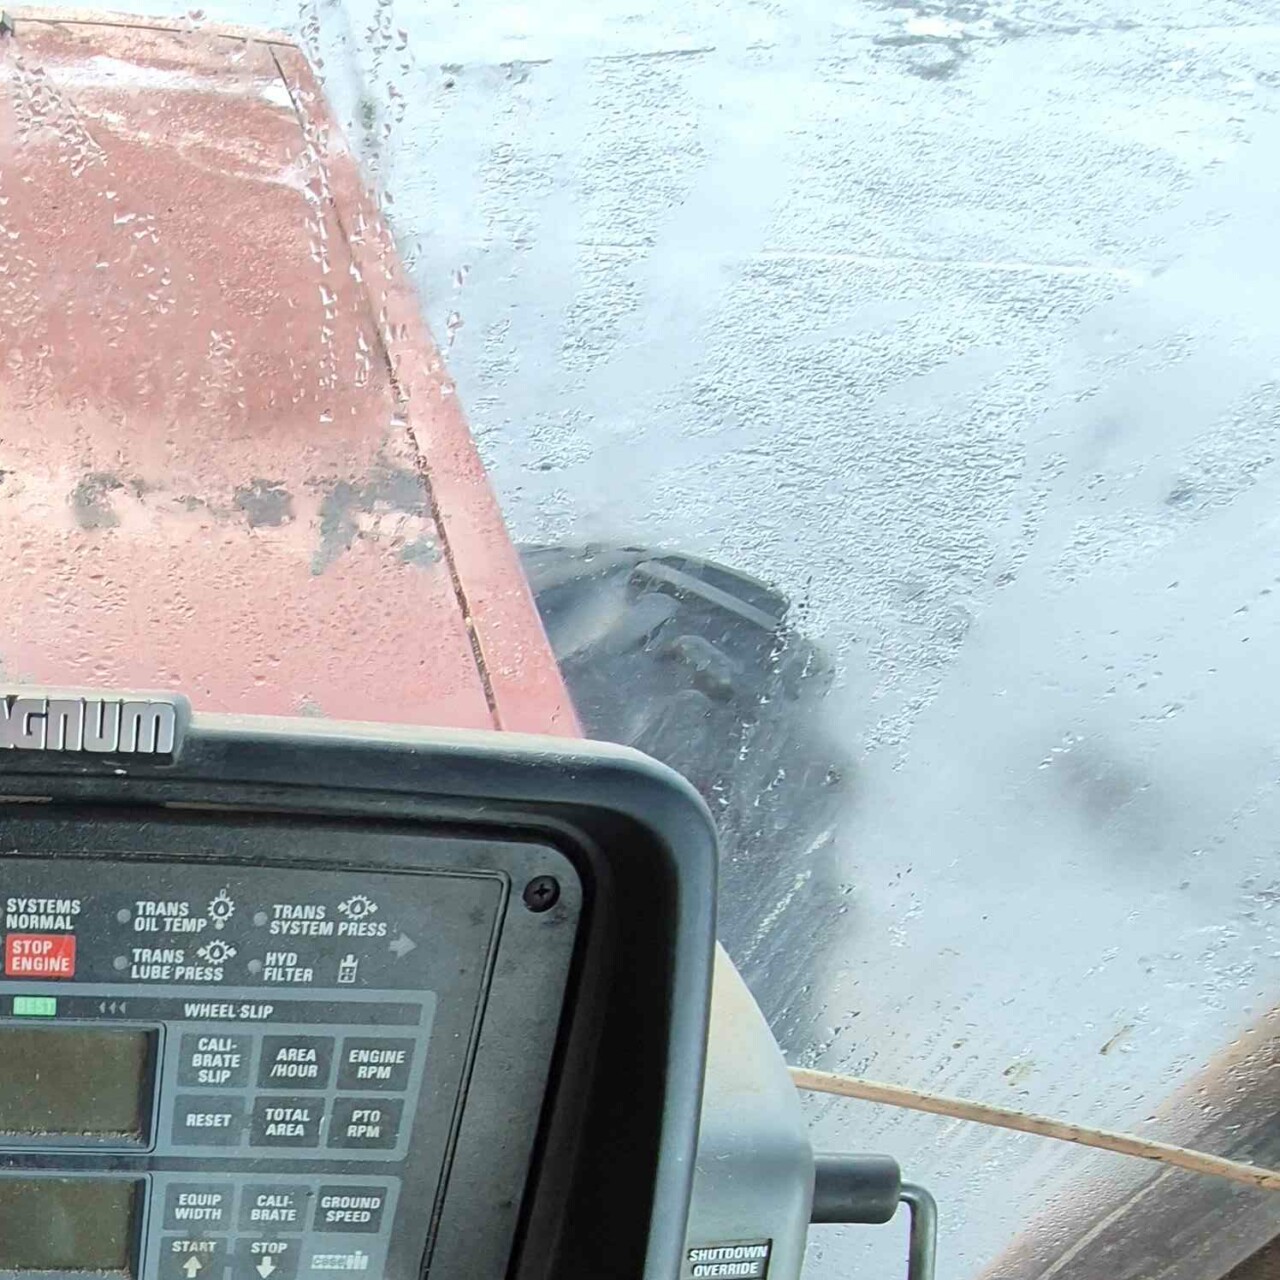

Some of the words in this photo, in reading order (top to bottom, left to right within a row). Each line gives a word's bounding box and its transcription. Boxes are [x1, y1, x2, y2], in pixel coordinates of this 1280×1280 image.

[6, 898, 81, 914] SYSTEMS
[136, 901, 189, 916] TRANS
[273, 904, 326, 920] TRANS
[6, 914, 74, 930] NORMAL
[134, 917, 159, 931] OIL
[163, 917, 208, 933] TEMP
[270, 921, 333, 936] SYSTEM
[337, 922, 387, 937] PRESS
[12, 940, 52, 955] STOP
[132, 948, 185, 964] TRANS
[266, 952, 297, 967] HYD
[12, 957, 70, 972] ENGINE
[131, 965, 171, 979] LUBE
[174, 967, 224, 981] PRESS
[264, 967, 313, 982] FILTER
[184, 1003, 237, 1018] WHEEL
[239, 1004, 273, 1019] SLIP
[198, 1038, 238, 1051] CALI-
[192, 1054, 241, 1068] BRATE
[277, 1048, 317, 1062] AREA
[349, 1050, 406, 1064] ENGINE
[198, 1070, 231, 1083] SLIP
[270, 1064, 318, 1078] /HOUR
[357, 1066, 392, 1079] RPM
[186, 1114, 232, 1127] RESET
[265, 1108, 311, 1122] TOTAL
[352, 1110, 381, 1123] PTO
[265, 1124, 305, 1136] AREA
[347, 1125, 380, 1138] RPM
[178, 1194, 222, 1207] EQUIP
[256, 1195, 293, 1207] CALI-
[321, 1196, 381, 1210] GROUND
[175, 1208, 222, 1220] WIDTH
[251, 1209, 297, 1222] BRATE
[326, 1211, 371, 1223] SPEED
[172, 1241, 217, 1253] START
[251, 1242, 288, 1254] STOP
[688, 1246, 768, 1261] SHUTDOWN
[693, 1262, 759, 1277] OVERRIDE
